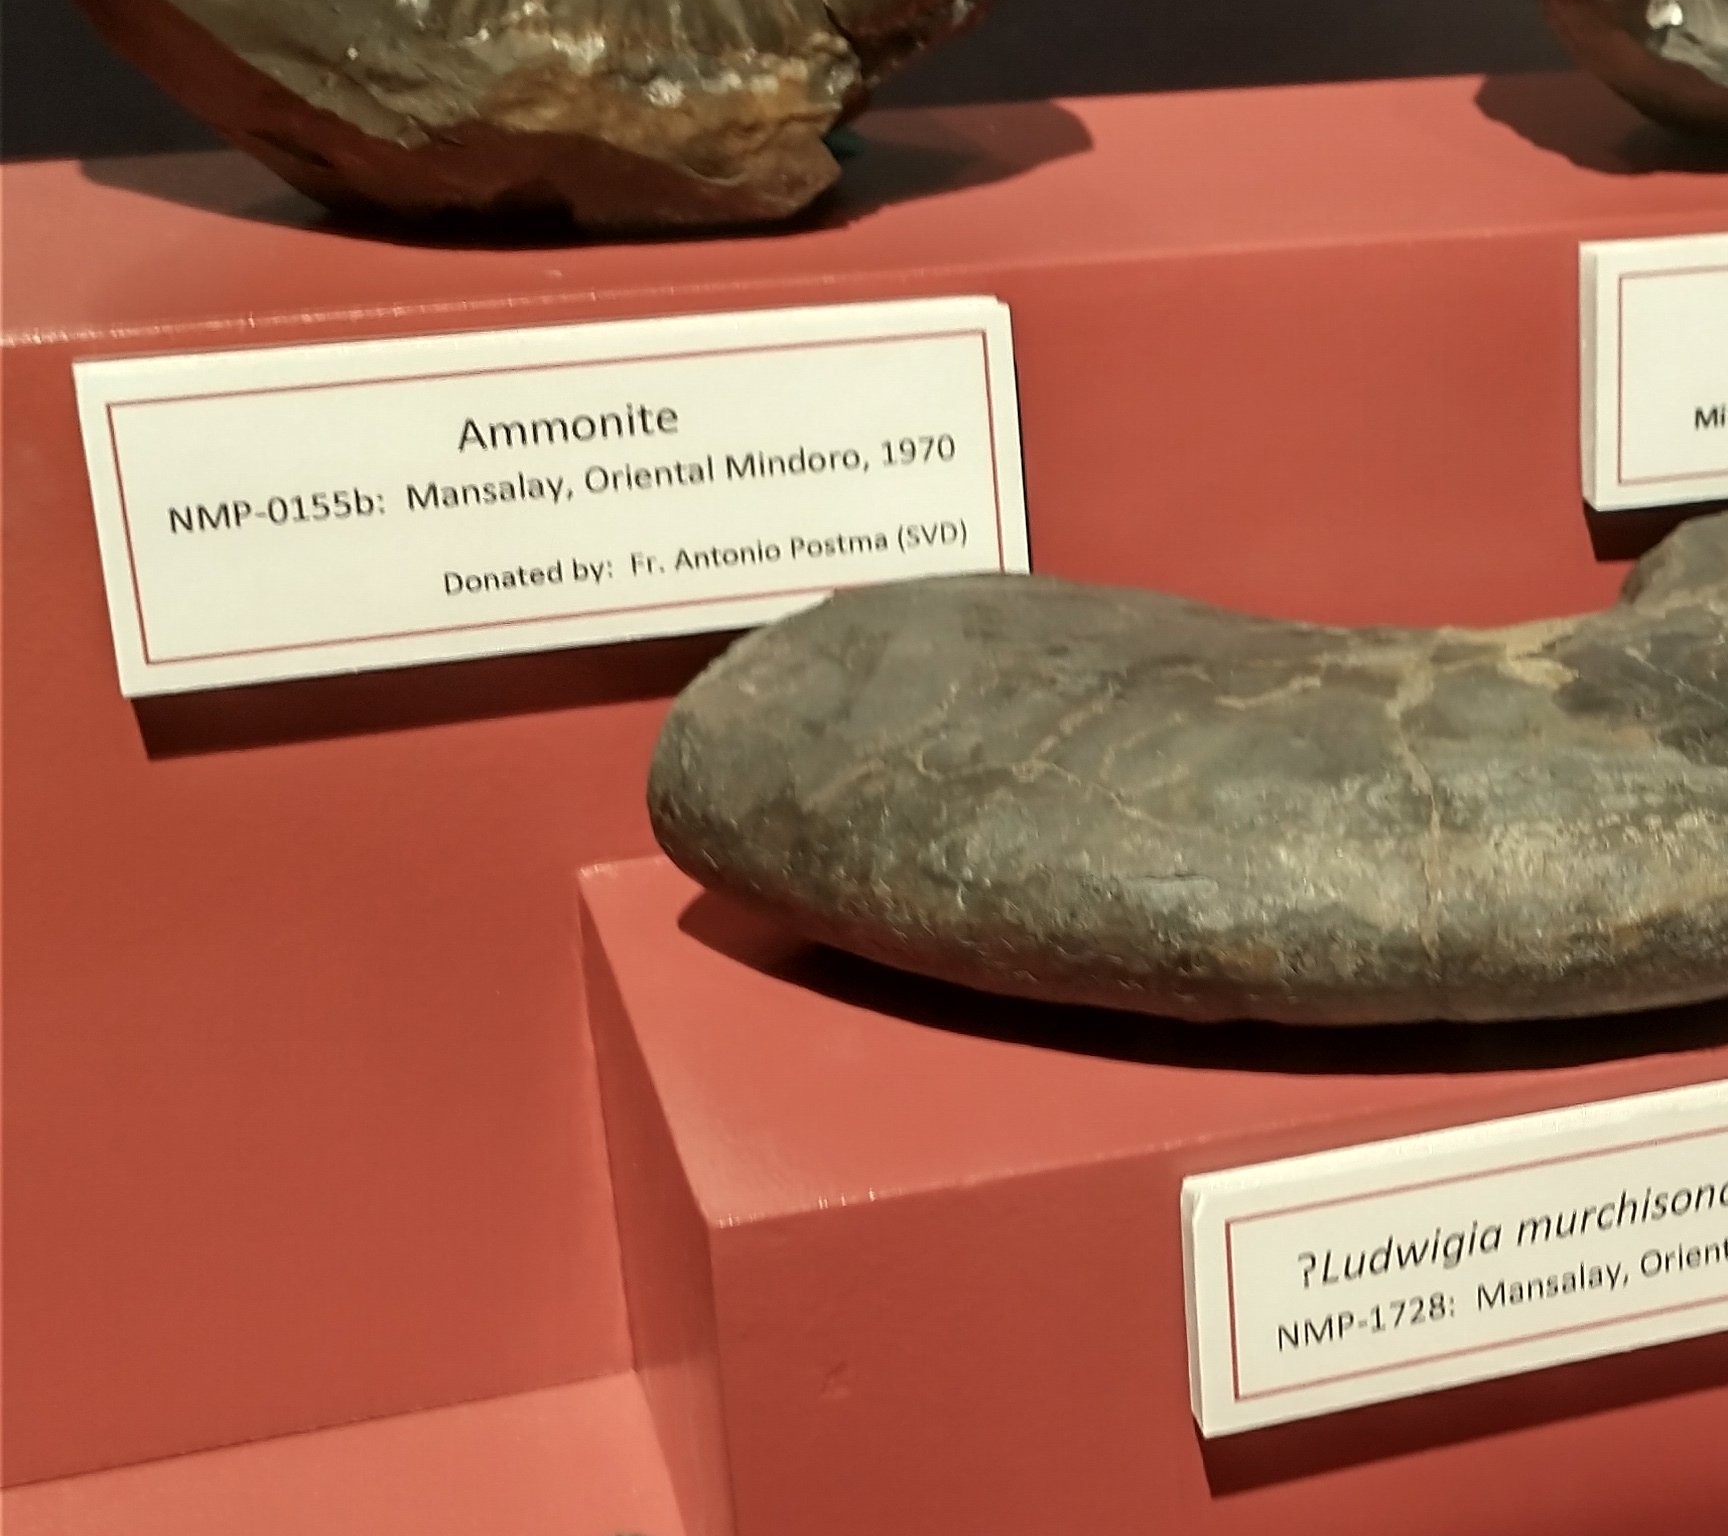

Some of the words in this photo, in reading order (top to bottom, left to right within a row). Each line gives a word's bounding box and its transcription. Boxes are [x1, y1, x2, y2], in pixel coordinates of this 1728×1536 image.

[456, 401, 680, 455] Ammonite
[166, 485, 387, 536] NMP-0155b:
[405, 469, 575, 514] Mansalay,
[583, 452, 716, 495] Oriental
[723, 444, 871, 482] Mindoro,
[880, 432, 957, 467] 1970
[442, 558, 565, 598] Donated
[570, 556, 614, 586] by:
[629, 551, 666, 578] Fr.
[672, 538, 783, 573] Antonio
[789, 531, 890, 561] Postma
[896, 516, 969, 556] (SVD)
[1296, 1218, 1503, 1292] ?Ludwigia
[1276, 1289, 1456, 1354] NMP-1728:
[1476, 1258, 1630, 1313] Mansalay,
